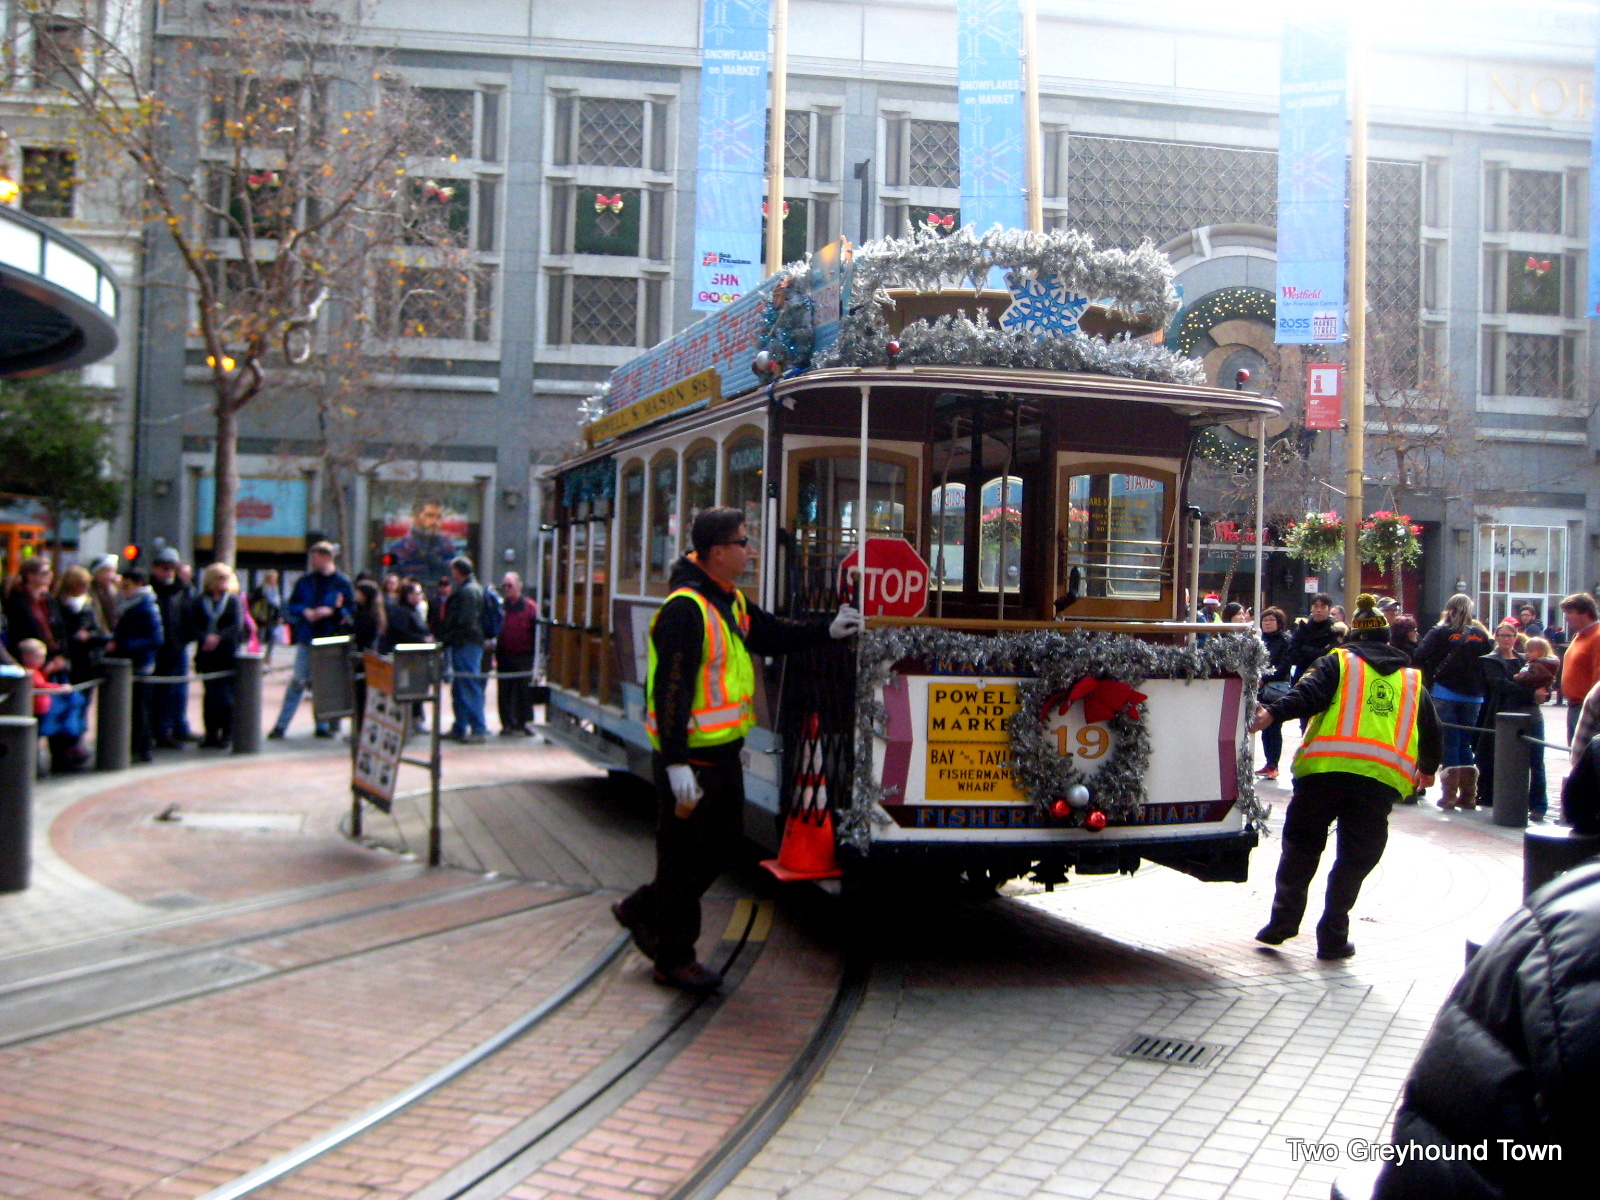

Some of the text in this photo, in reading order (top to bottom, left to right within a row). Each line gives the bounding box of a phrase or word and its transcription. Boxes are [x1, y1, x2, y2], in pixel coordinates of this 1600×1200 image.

[704, 49, 766, 62] SNOWFLAKES
[708, 64, 761, 77] on MARKET
[960, 79, 1019, 91] SNOWFLAKES
[965, 94, 1015, 105] on MARKET
[711, 273, 739, 286] SHN
[1282, 286, 1322, 299] Westfield
[1280, 318, 1310, 329] ROSS
[1313, 319, 1337, 327] MARKET
[960, 706, 1004, 715] AND
[932, 717, 1010, 731] MARKE
[1050, 725, 1109, 759] 19
[931, 750, 955, 764] BAY
[979, 750, 1015, 765] TAYL
[939, 769, 1015, 780] FISHERMANS
[958, 782, 998, 792] WHARF
